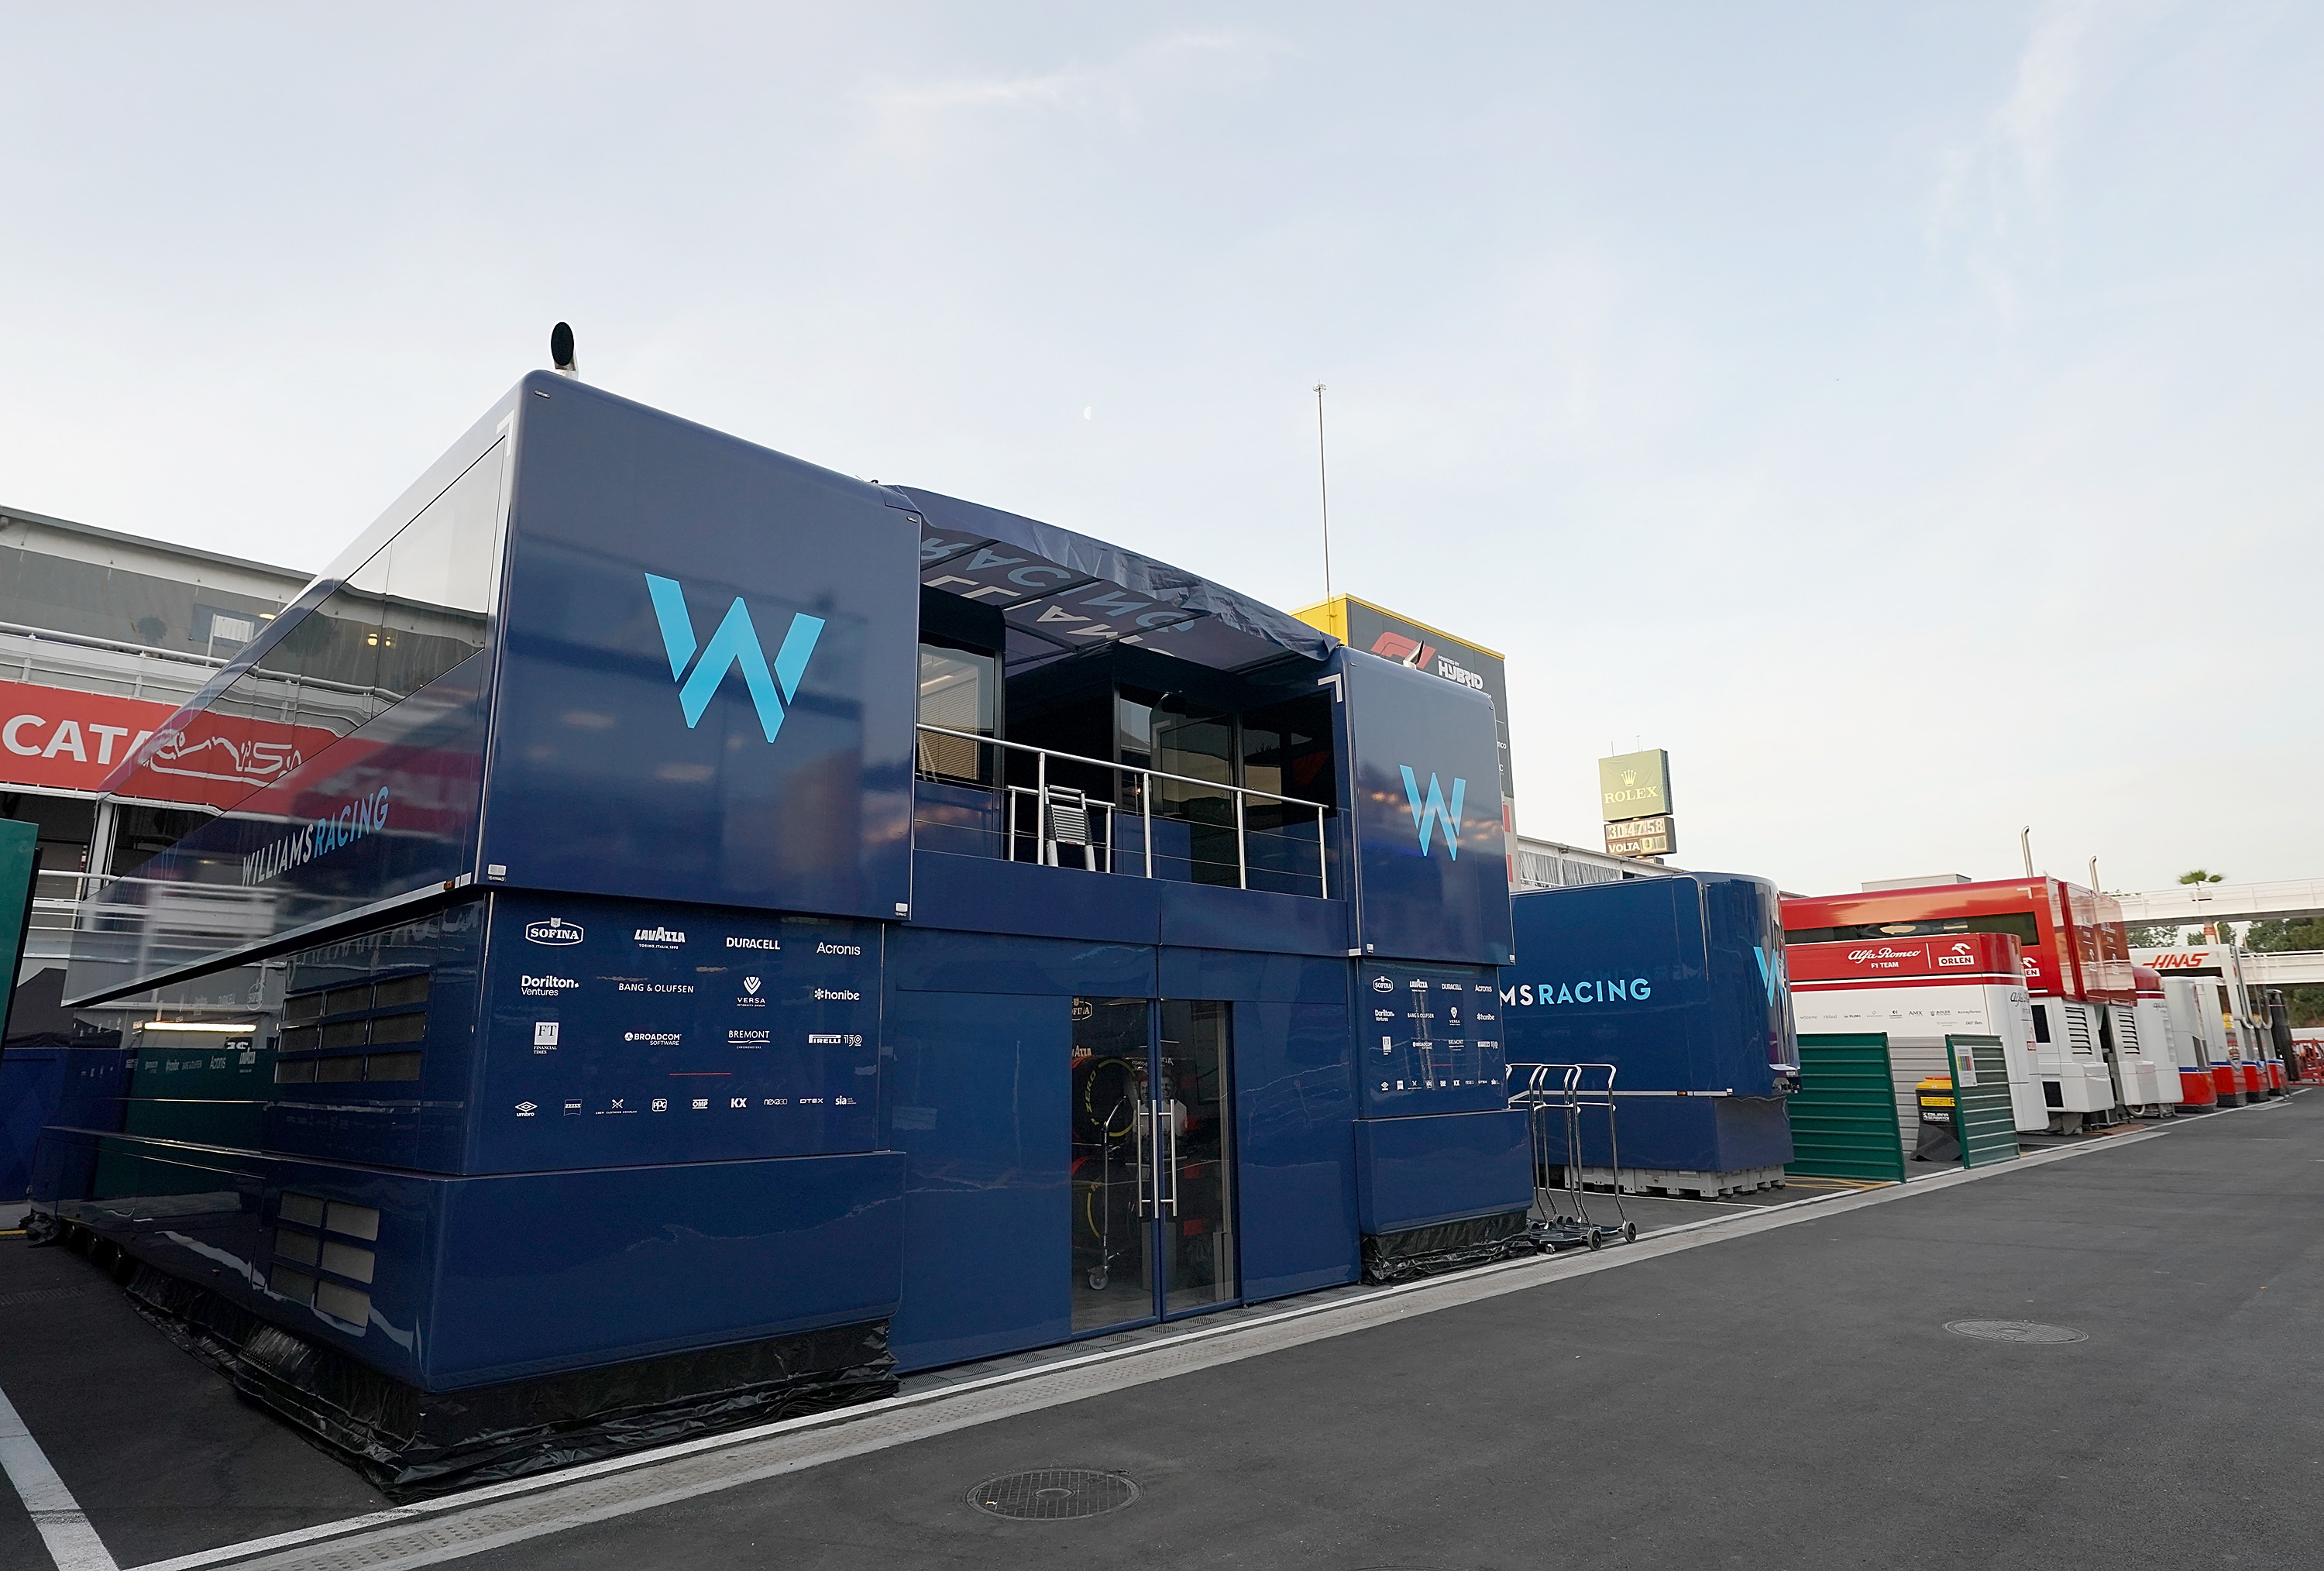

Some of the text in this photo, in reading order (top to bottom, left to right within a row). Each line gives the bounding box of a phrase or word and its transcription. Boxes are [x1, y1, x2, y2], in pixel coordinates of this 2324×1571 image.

[645, 572, 827, 744] W
[1438, 660, 1483, 689] HYBRID
[1604, 786, 1658, 804] ROLEX
[1399, 764, 1467, 861] W
[1608, 842, 1640, 854] VOLTA
[531, 928, 579, 940] SOFINA
[634, 927, 686, 943] LAVAZZA
[726, 937, 781, 950] DURACELL
[816, 942, 861, 956] Acronis
[1941, 957, 1972, 965] ORLEN
[2143, 953, 2210, 969] HAAS
[521, 988, 559, 996] Ventures
[618, 983, 645, 992] BANG
[655, 984, 694, 993] OLUFSEN
[1538, 978, 1652, 1006] RACING
[825, 989, 860, 1001] honibe
[538, 1025, 557, 1036] FT
[728, 1030, 770, 1039] BREMONT
[809, 1034, 841, 1043] PIRELLI
[652, 1100, 666, 1110] PPG
[693, 1099, 708, 1108] OMP
[731, 1098, 748, 1109] KX
[835, 1095, 847, 1105] sia
